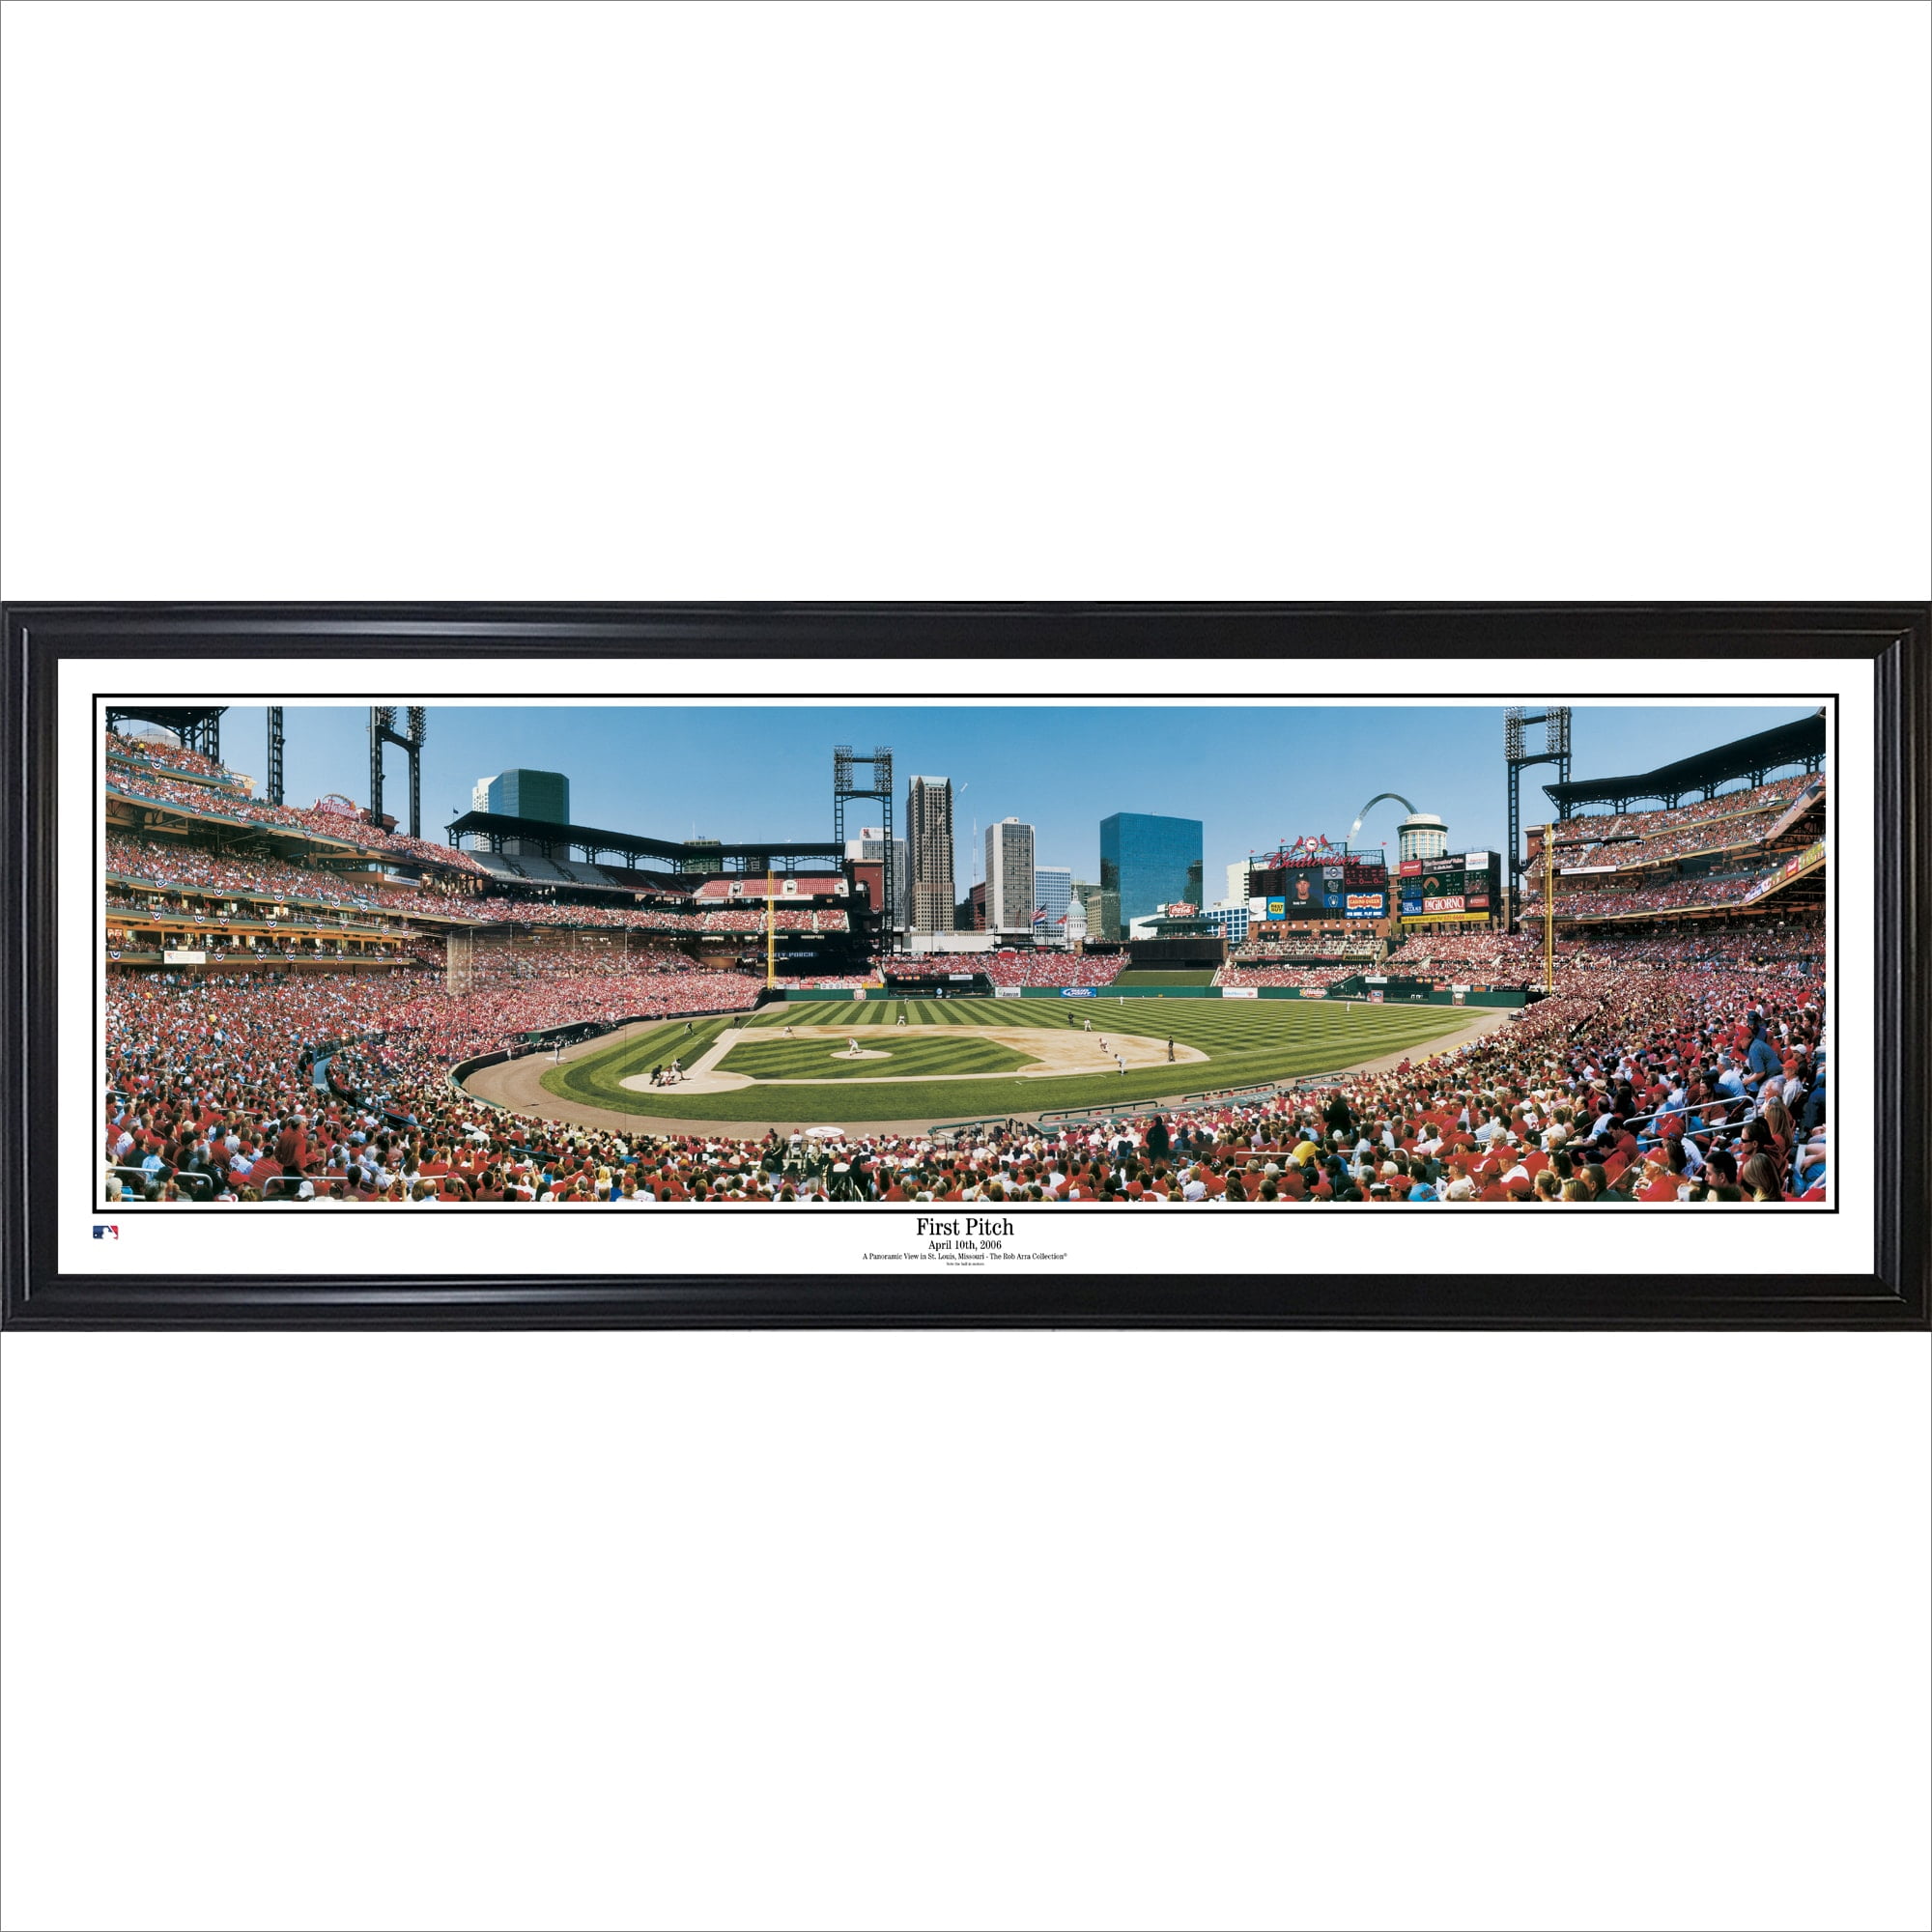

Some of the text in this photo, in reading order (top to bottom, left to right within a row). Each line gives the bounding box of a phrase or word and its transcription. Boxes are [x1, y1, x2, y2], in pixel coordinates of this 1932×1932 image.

[1264, 852, 1361, 870] Budweiser
[917, 1218, 1015, 1236] First Pitch
[928, 1240, 1002, 1251] April 10th, 2006
